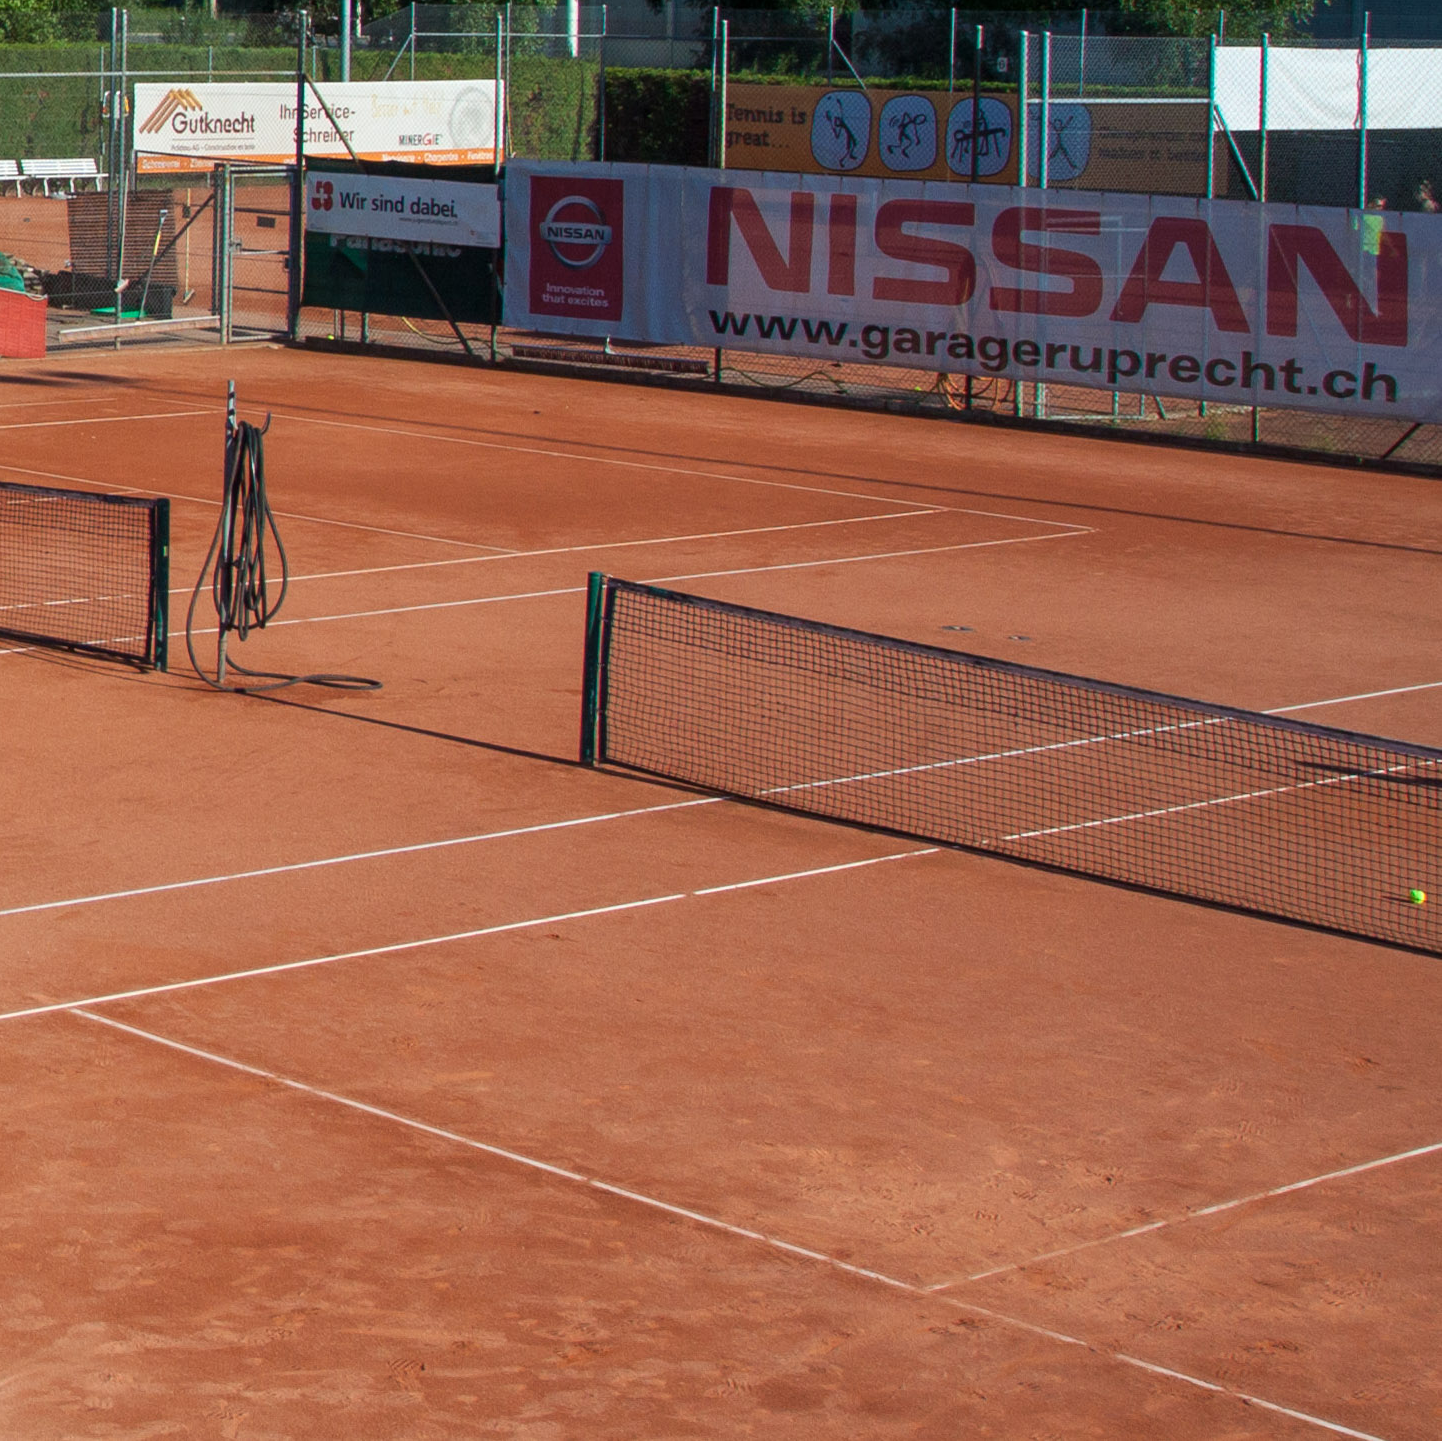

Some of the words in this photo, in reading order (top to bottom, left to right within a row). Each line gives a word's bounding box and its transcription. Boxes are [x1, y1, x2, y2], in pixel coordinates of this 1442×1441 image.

[172, 111, 255, 134] Gutknecht
[726, 103, 784, 124] Tennis
[791, 106, 807, 125] is
[398, 132, 440, 146] MINERGIE
[340, 192, 367, 209] Wir
[371, 194, 405, 214] sind
[410, 197, 458, 218] dabei.
[547, 226, 605, 241] NISSAN
[706, 186, 1409, 348] NISSAN
[546, 282, 605, 297] Innovation
[542, 293, 565, 305] that
[567, 297, 609, 309] excites
[708, 309, 1398, 403] www.garageruprecht.ch
